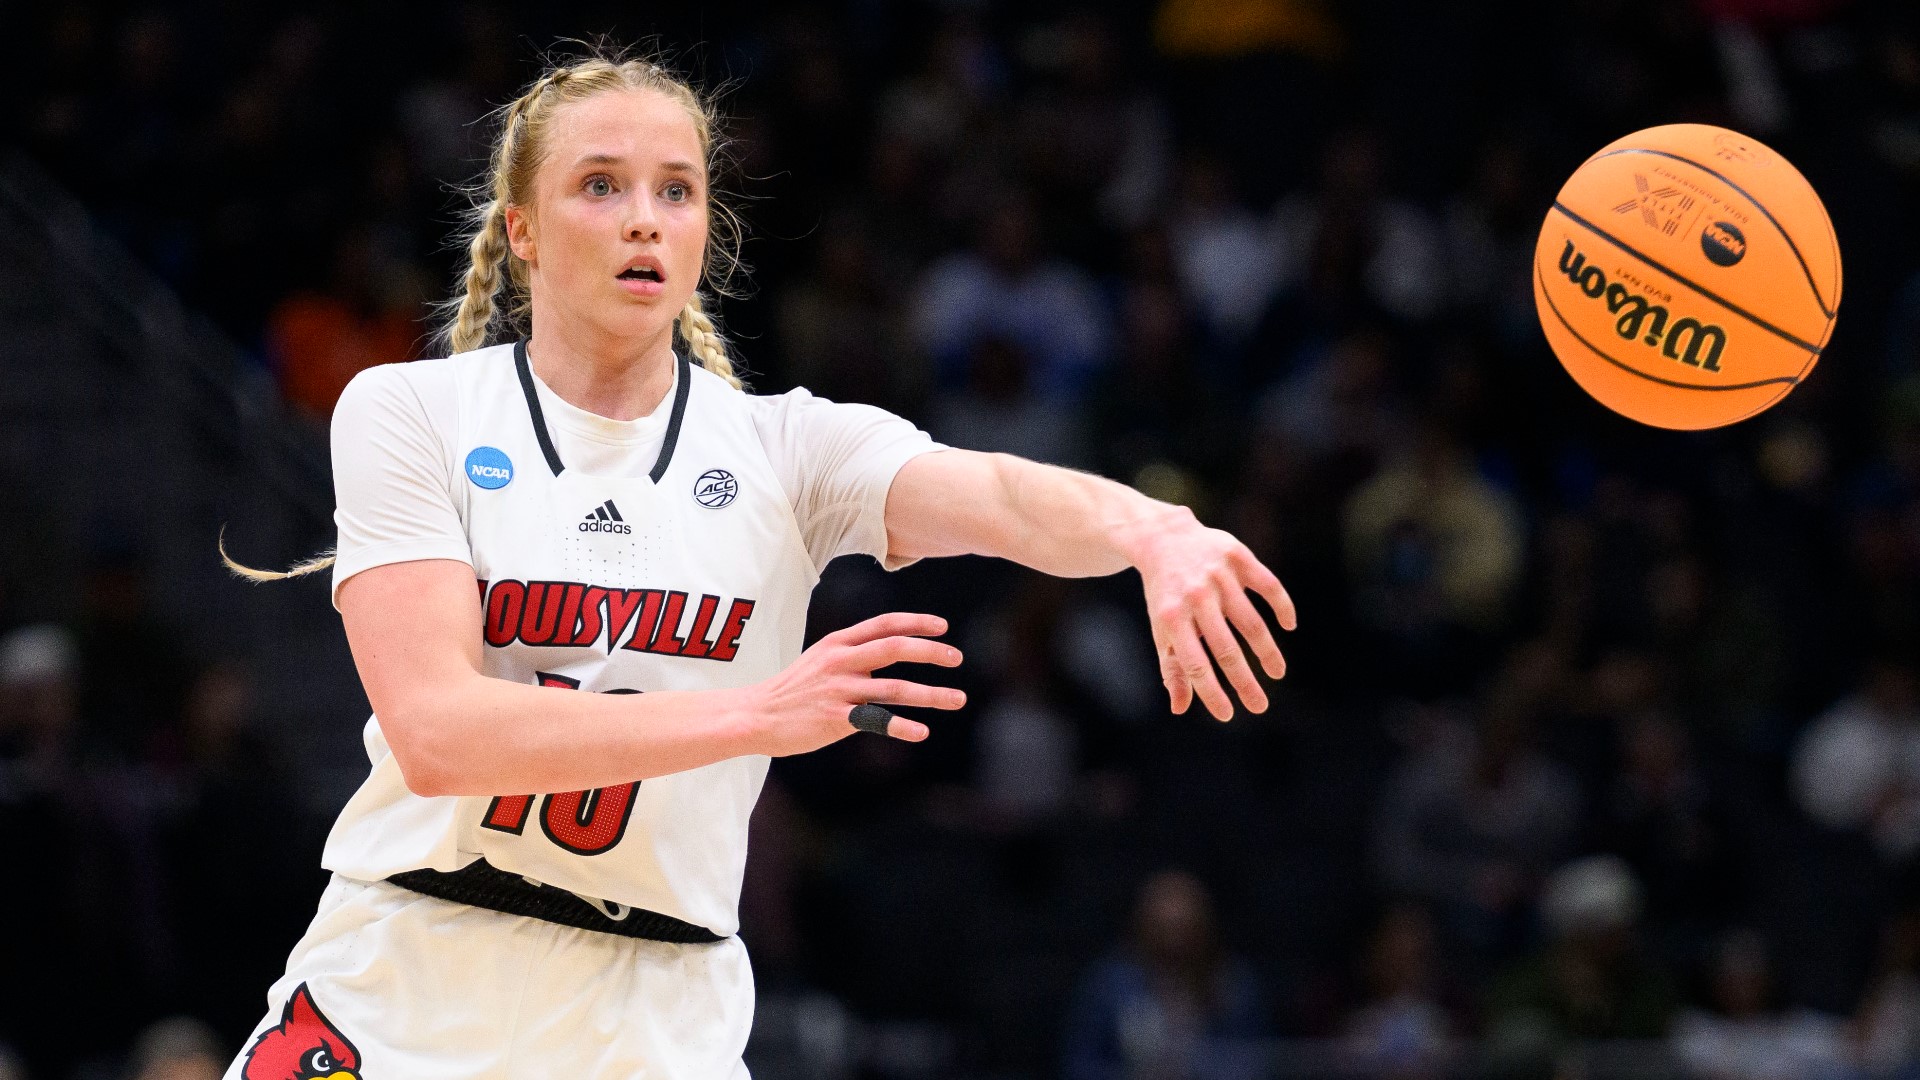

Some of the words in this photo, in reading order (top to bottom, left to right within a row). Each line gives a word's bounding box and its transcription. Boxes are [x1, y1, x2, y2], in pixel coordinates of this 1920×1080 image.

[1559, 238, 1727, 373] Wilson
[471, 464, 511, 481] NCAA
[699, 478, 736, 495] ACC
[578, 520, 632, 535] adidas
